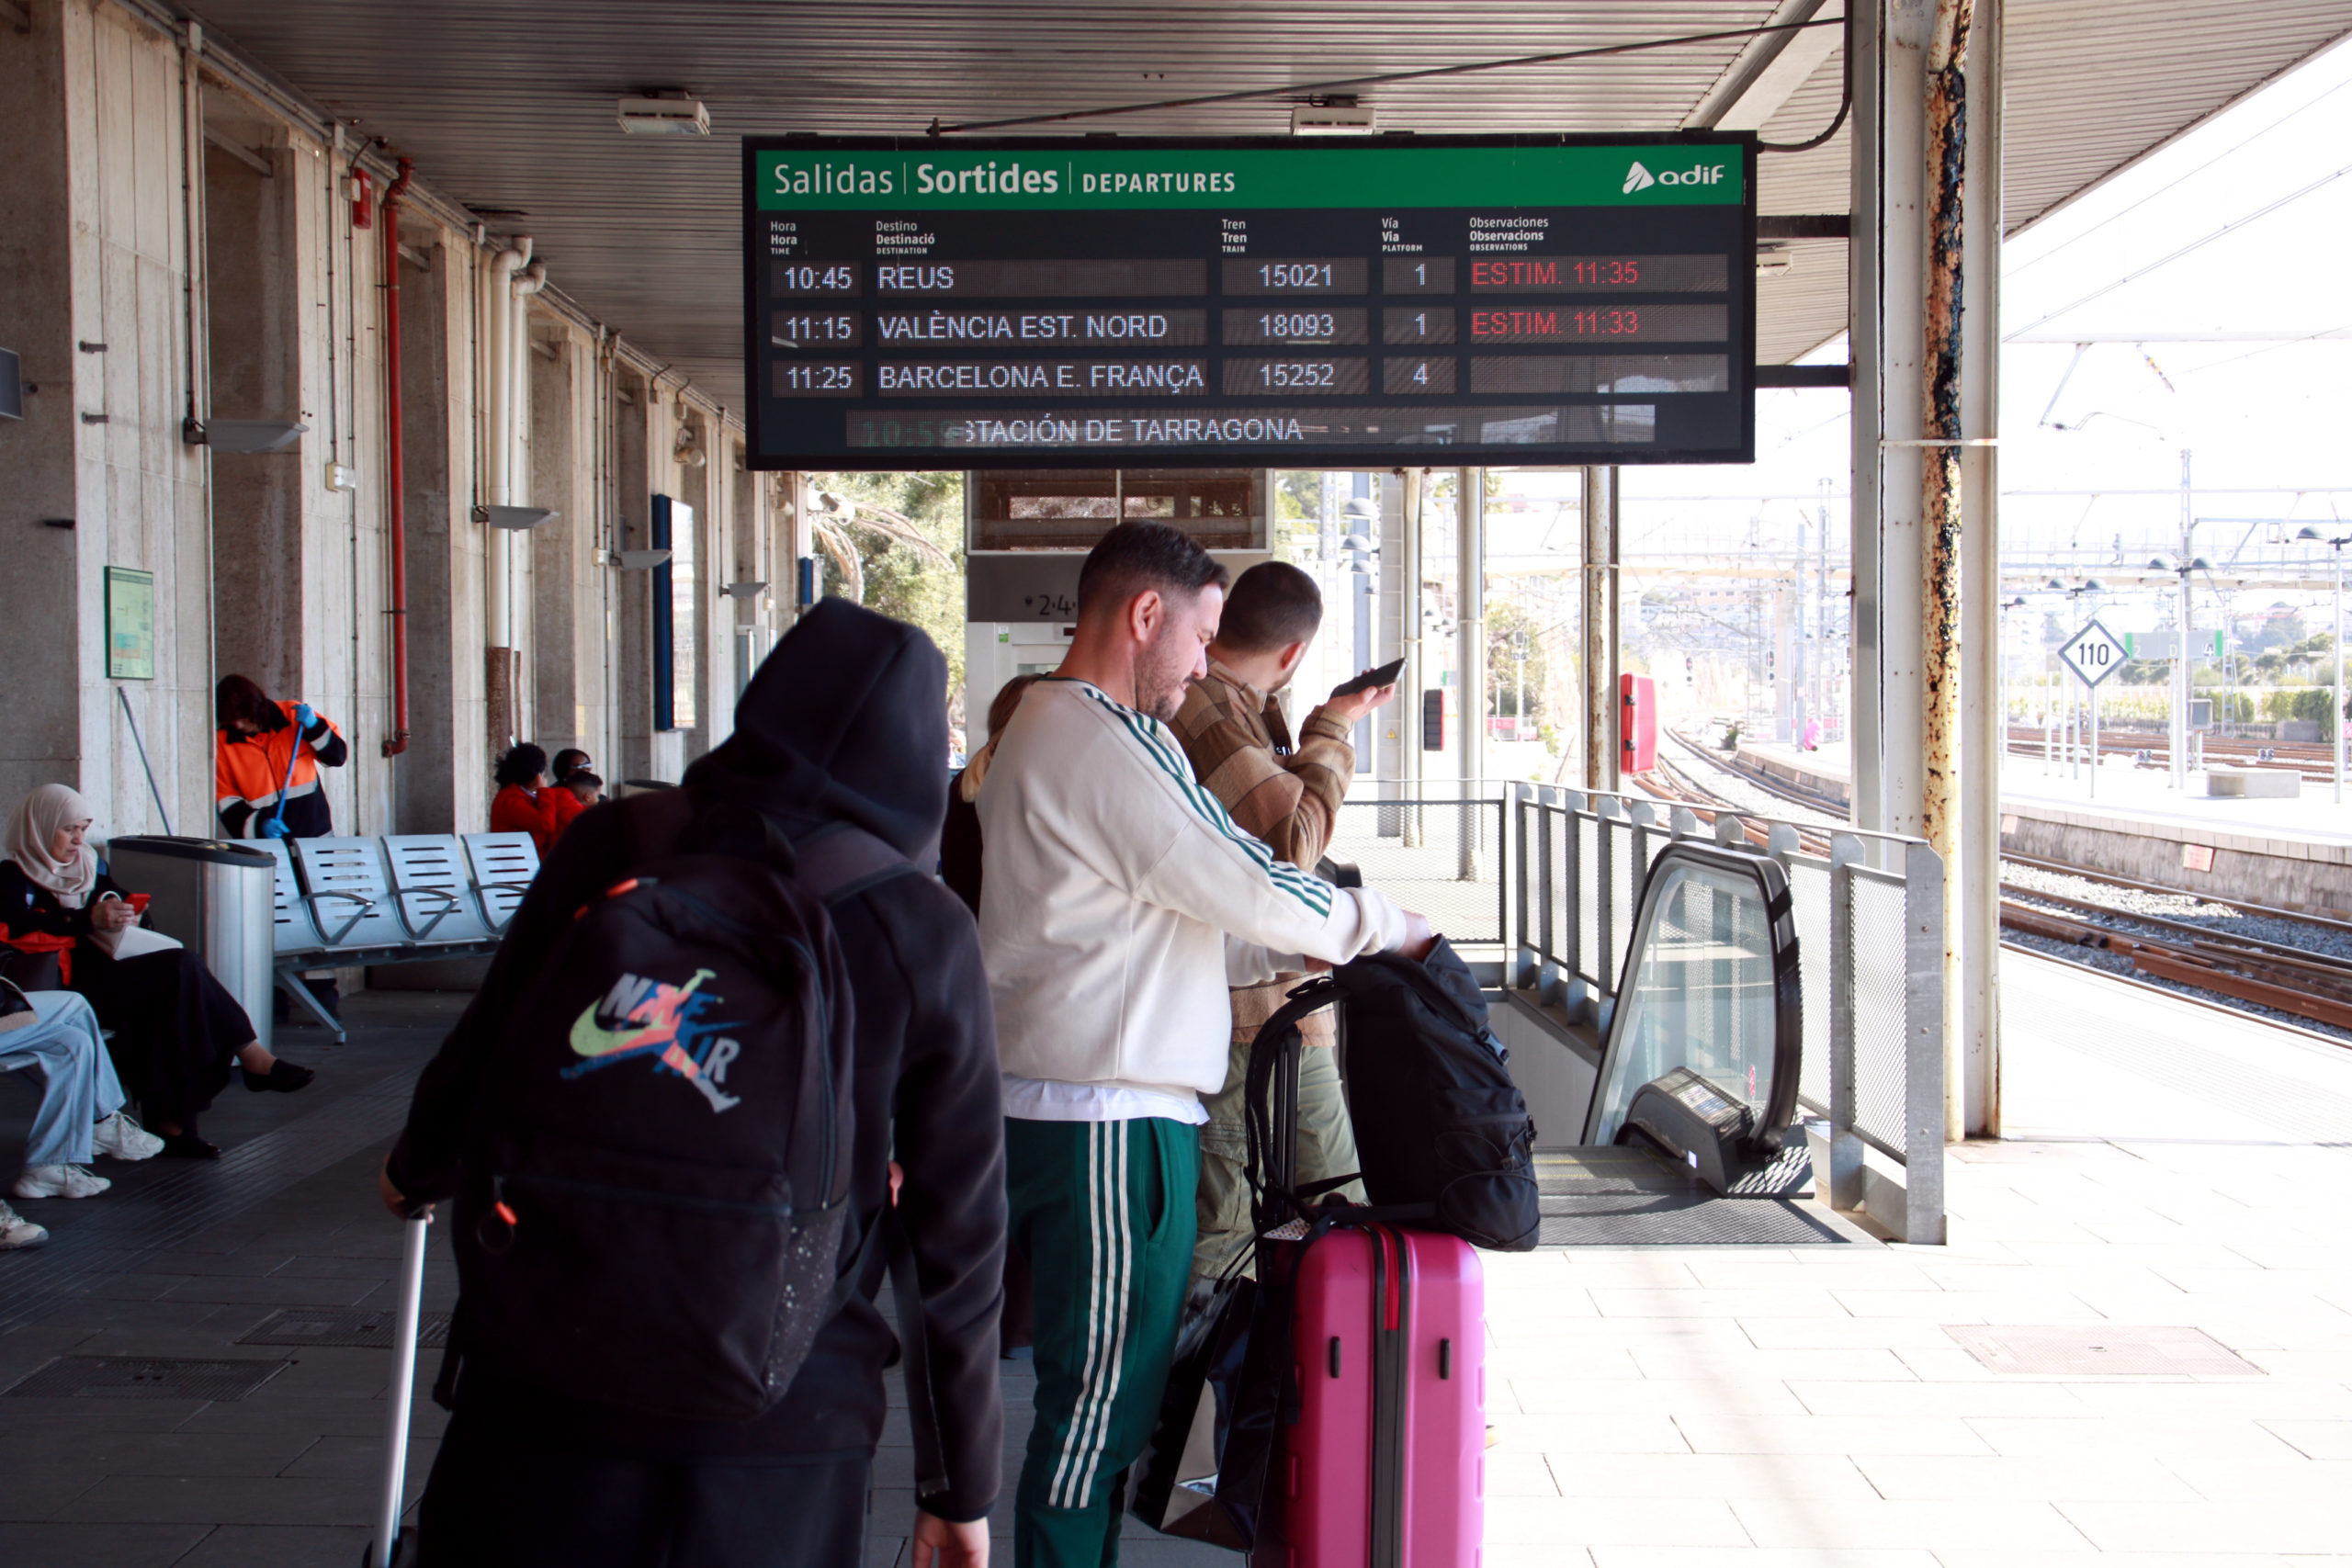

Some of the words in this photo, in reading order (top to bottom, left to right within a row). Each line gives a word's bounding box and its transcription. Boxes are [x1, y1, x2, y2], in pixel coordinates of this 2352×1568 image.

[775, 163, 893, 194] Salidas
[917, 161, 1058, 194] Sortides
[1082, 172, 1236, 193] DEPARTURES
[1657, 164, 1725, 186] adif
[770, 220, 797, 231] Hora
[876, 220, 918, 231] Destino
[1221, 219, 1246, 230] Tren
[1381, 217, 1399, 229] Vía
[1469, 216, 1549, 229] Observaciones
[771, 234, 797, 245] Hora
[876, 232, 935, 245] Destinació
[1221, 231, 1248, 243] Tren
[1381, 230, 1400, 242] Via
[1469, 229, 1544, 242] Observacions
[770, 247, 790, 255] TIME
[876, 246, 928, 254] DESTINATION
[1221, 244, 1246, 254] TRAIN
[1382, 243, 1423, 253] PLATFORM
[1469, 243, 1528, 252] OBSERVATIONS
[785, 266, 853, 289] 10:45
[878, 266, 955, 289] REUS
[1260, 264, 1331, 287] 15021
[1415, 264, 1425, 287] 1
[1472, 262, 1562, 285] ESTIM.
[1574, 261, 1639, 284] 11:35
[787, 317, 852, 339] 11:15
[878, 310, 1013, 339] VALÈNCIA
[1022, 315, 1077, 338] EST.
[1087, 315, 1168, 338] NORD
[1260, 313, 1334, 336] 18093
[1415, 313, 1426, 336] 1
[1472, 311, 1562, 335] ESTIM.
[1574, 310, 1639, 333] 11:33
[787, 367, 853, 389] 11:25
[879, 366, 1049, 389] BARCELONA
[1057, 365, 1081, 388] E.
[1091, 365, 1204, 394] FRANÇA
[1260, 363, 1334, 387] 15252
[1413, 363, 1429, 386] 4
[1085, 419, 1124, 443] DE
[1133, 418, 1304, 443] TARRAGONA
[2078, 642, 2109, 666] 110
